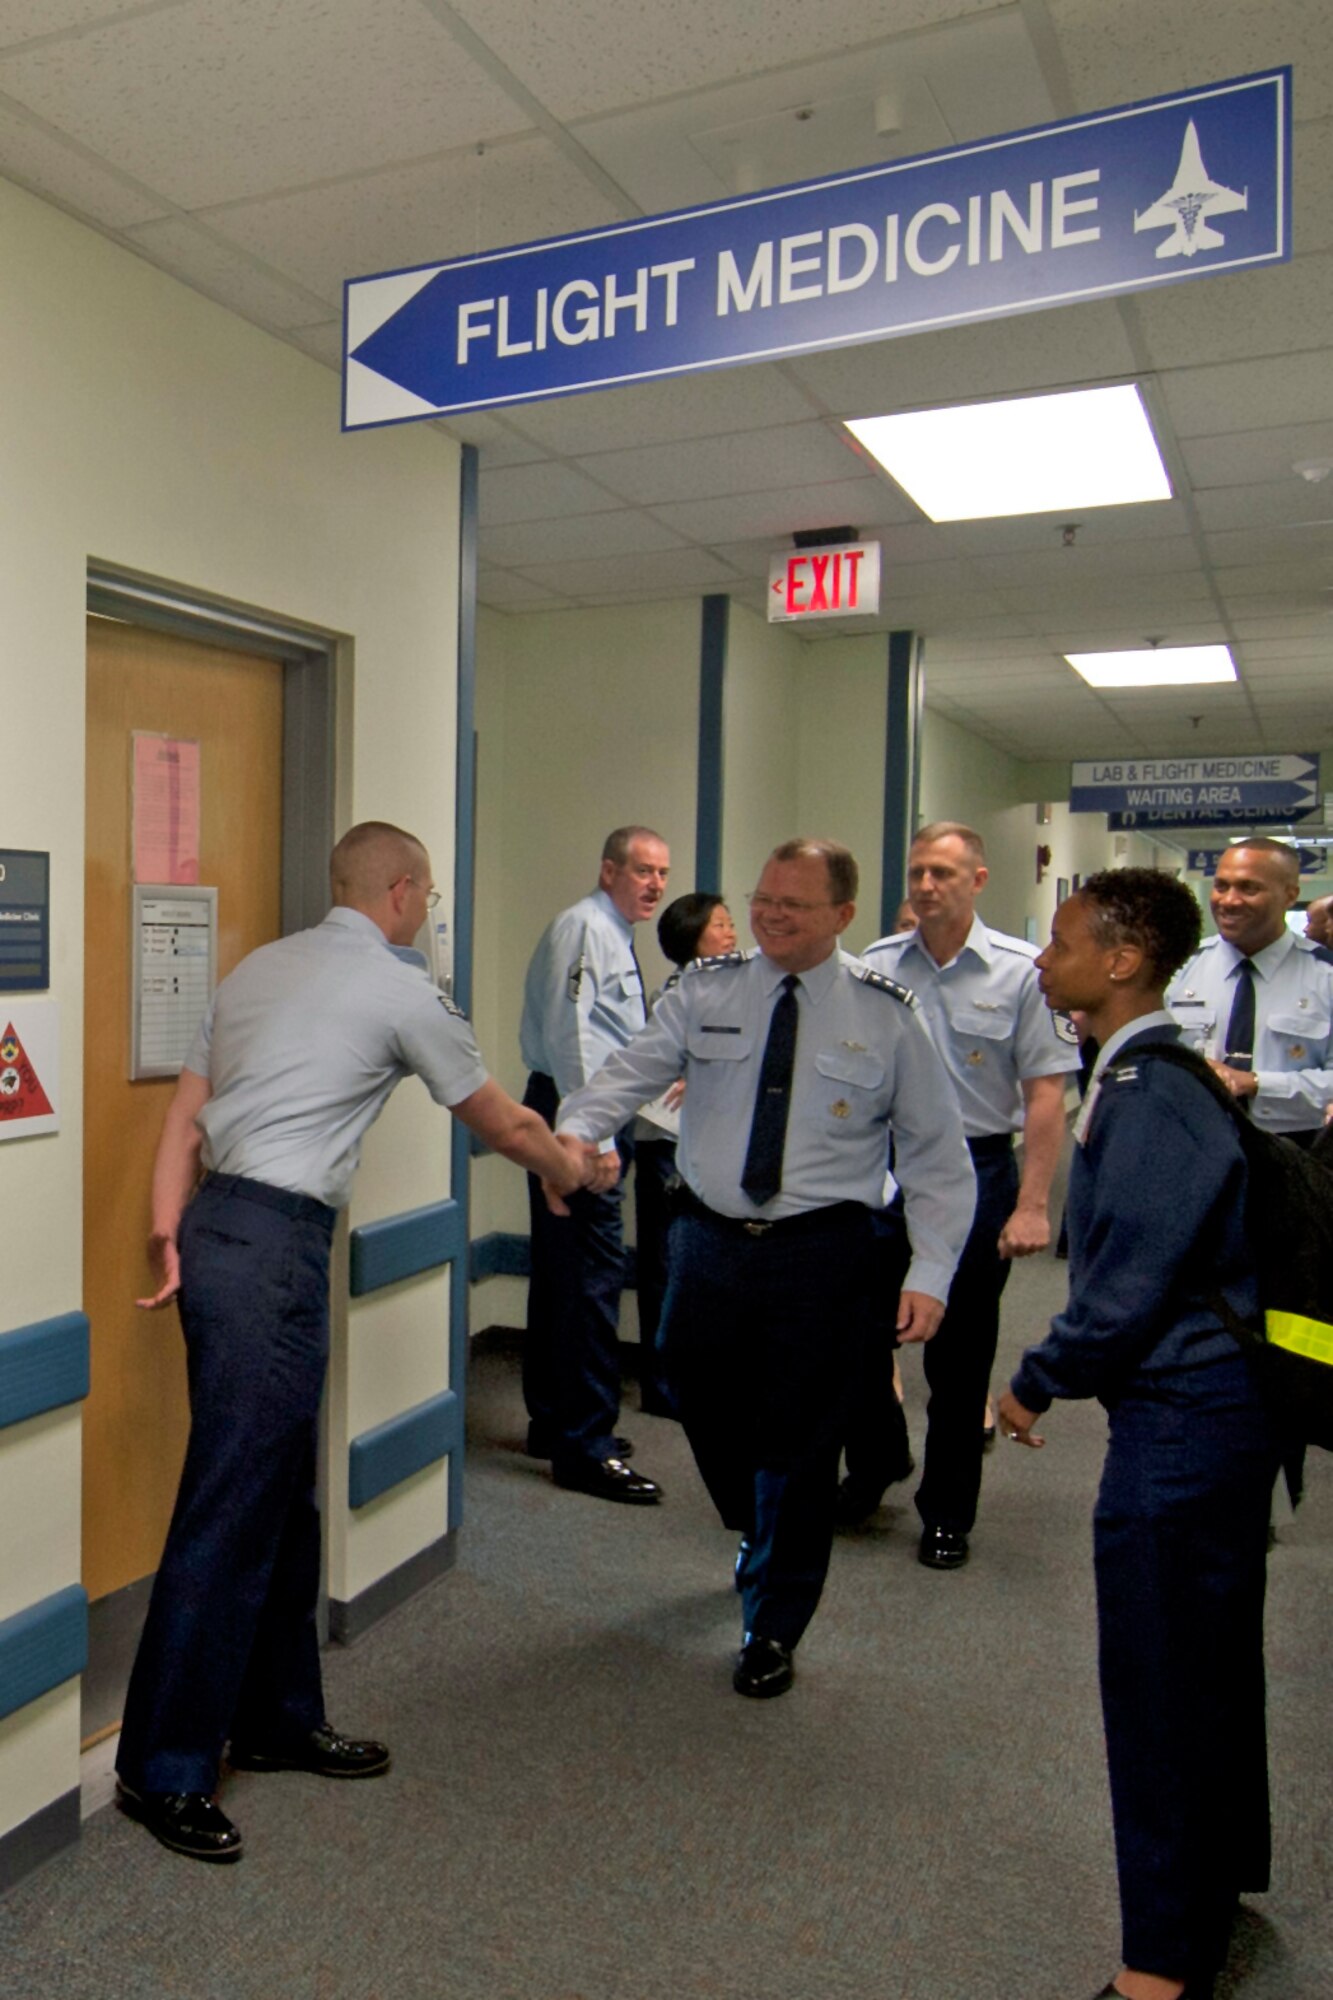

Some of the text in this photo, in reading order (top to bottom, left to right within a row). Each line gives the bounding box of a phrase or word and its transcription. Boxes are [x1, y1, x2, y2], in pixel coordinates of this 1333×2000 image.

[457, 168, 1101, 365] FLIGHT MEDICINE
[786, 550, 865, 614] EXIT
[1092, 760, 1281, 782] LAB & FLIGHT MEDICINE
[1126, 786, 1242, 806] WAITING AREA
